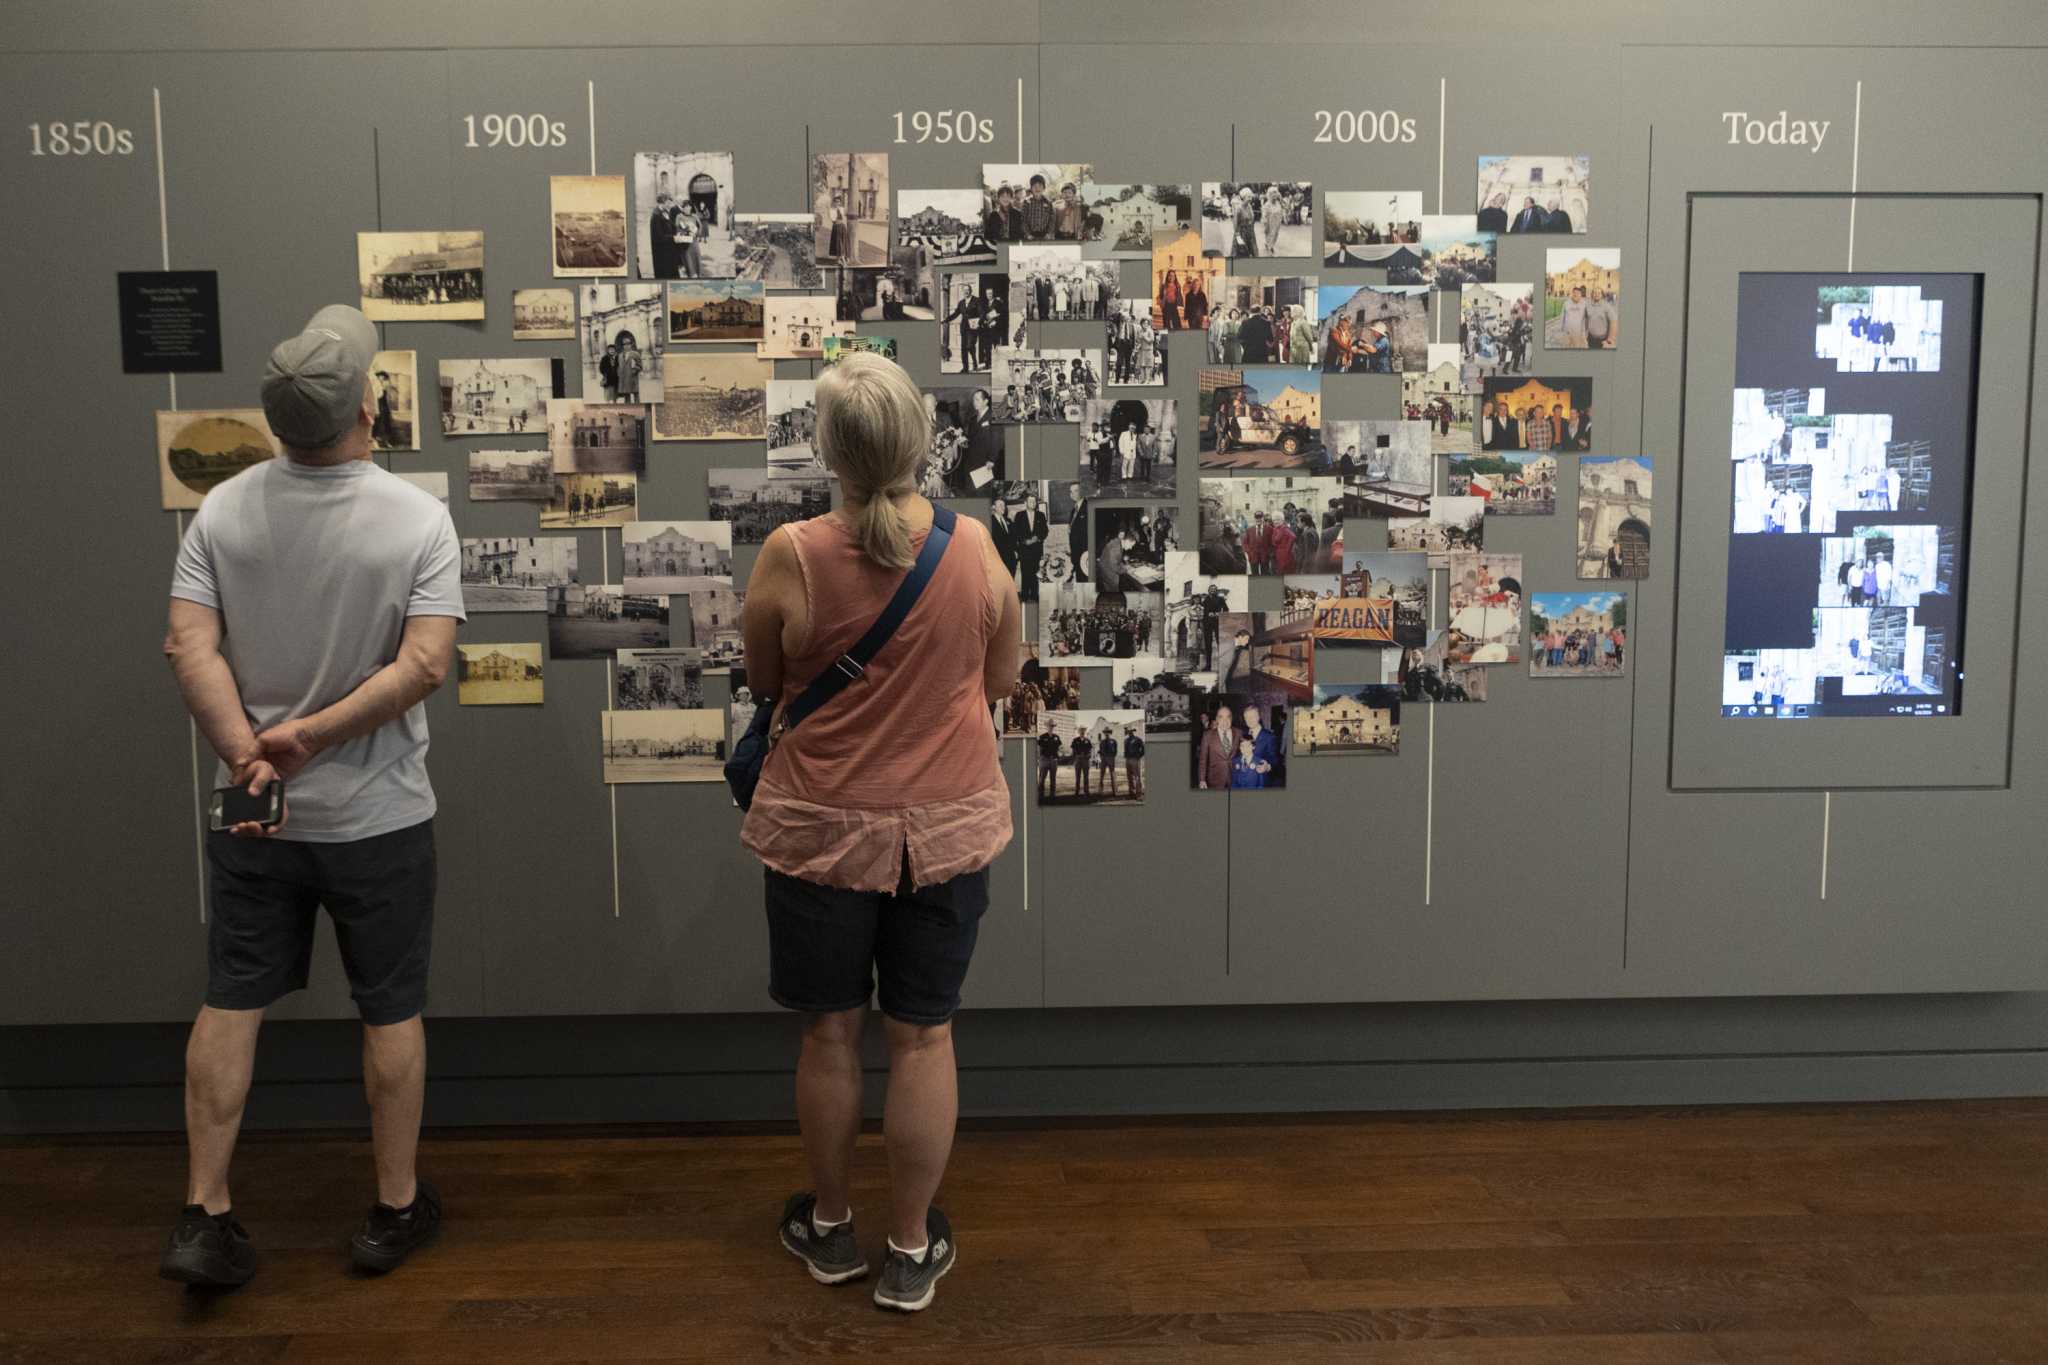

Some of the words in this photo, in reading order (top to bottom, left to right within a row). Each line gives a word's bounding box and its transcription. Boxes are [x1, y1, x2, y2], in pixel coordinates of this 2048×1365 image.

[29, 121, 134, 156] 1850s
[464, 114, 567, 148] 1900s
[892, 111, 995, 145] 1950s
[1313, 110, 1418, 144] 2000s
[1722, 110, 1831, 153] Today
[1317, 607, 1390, 630] REAGAN
